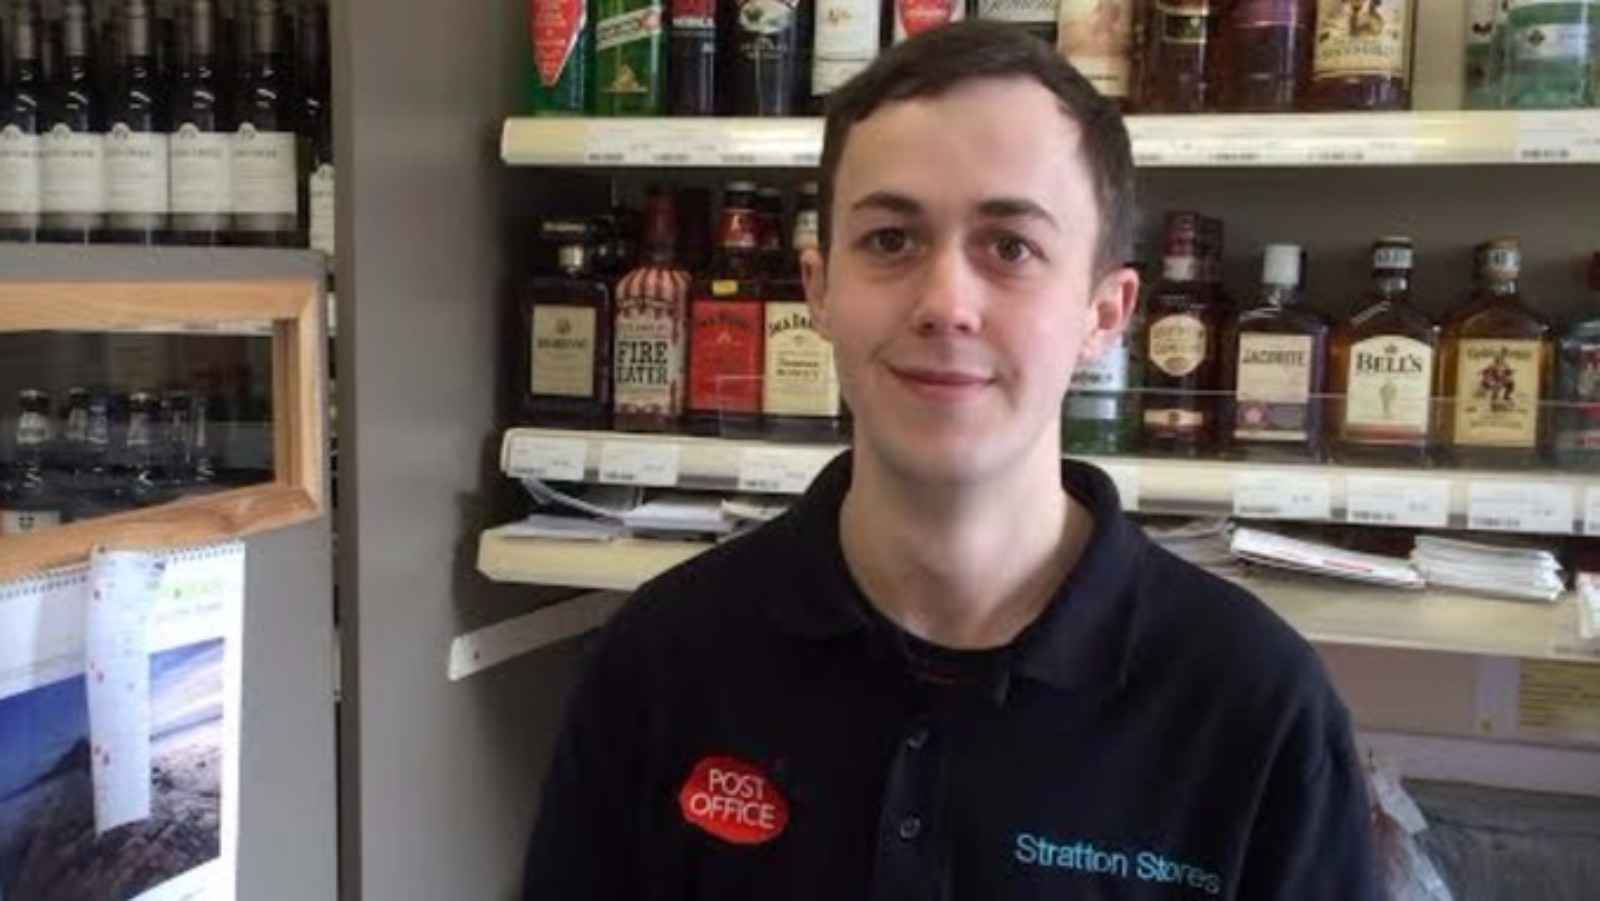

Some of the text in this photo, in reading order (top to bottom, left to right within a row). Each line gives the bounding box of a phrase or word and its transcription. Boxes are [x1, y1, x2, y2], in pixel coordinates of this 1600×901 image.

[617, 340, 669, 364] FIRE
[1355, 351, 1423, 374] BELL'S
[615, 366, 669, 386] EATER
[708, 768, 764, 801] POST
[689, 791, 776, 829] OFFICE
[1015, 833, 1221, 895] Stratton Stores
